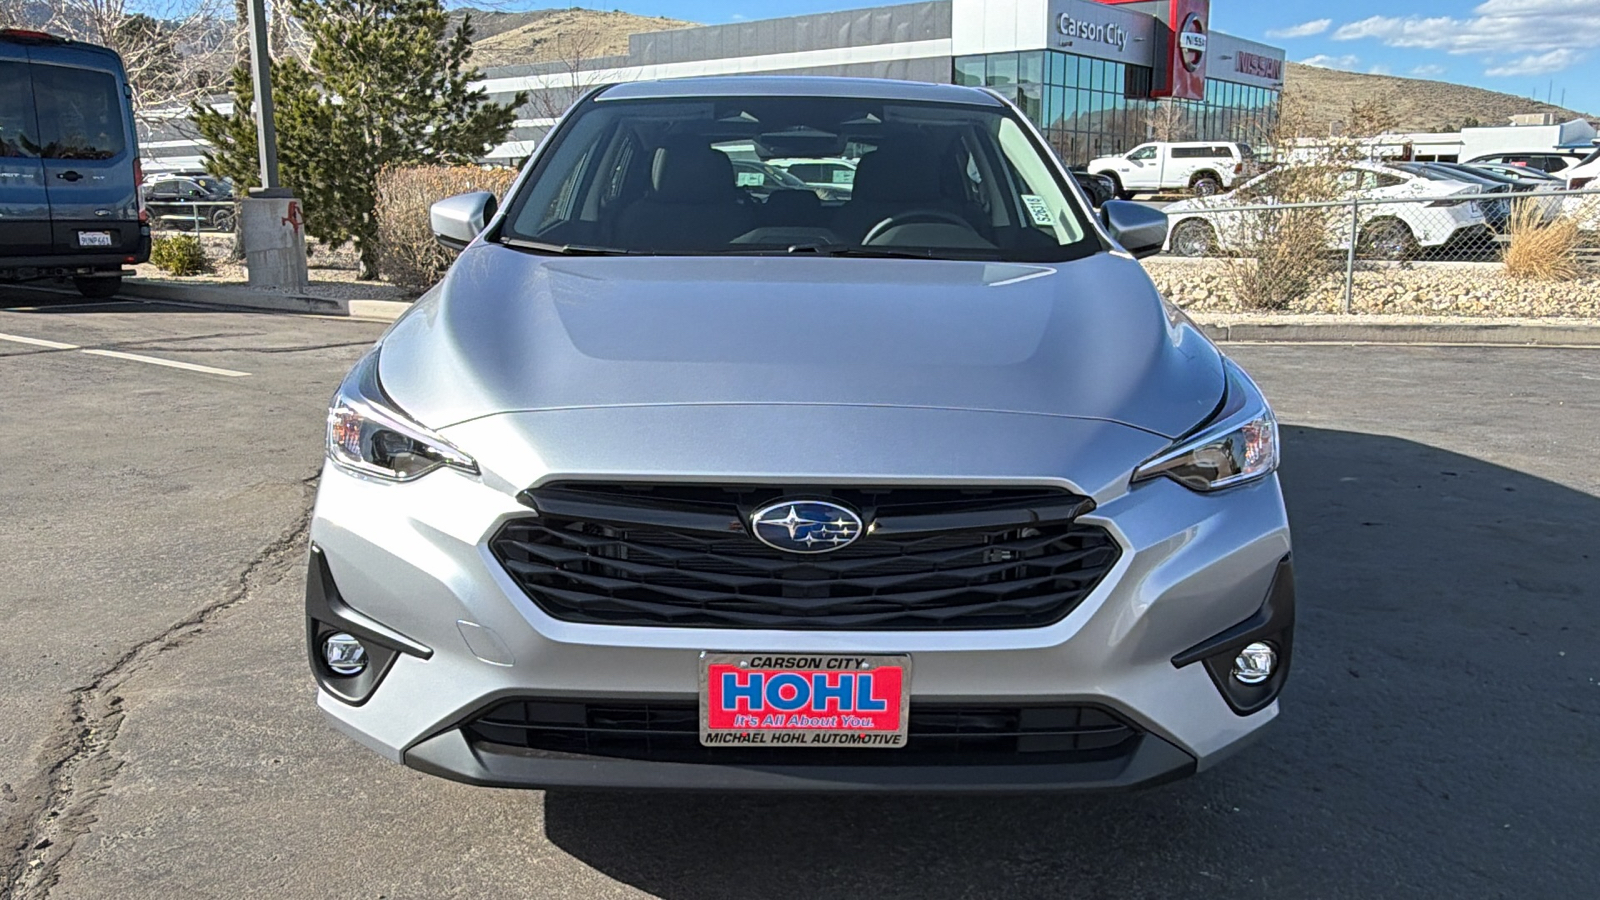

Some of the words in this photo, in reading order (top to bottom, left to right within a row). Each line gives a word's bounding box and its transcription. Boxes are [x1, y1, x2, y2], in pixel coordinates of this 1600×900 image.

[1059, 12, 1104, 42] Carson
[1107, 22, 1129, 52] City
[1186, 35, 1206, 47] NISS
[1235, 51, 1282, 80] NISSAN
[750, 656, 825, 669] CARSON
[827, 657, 866, 669] CITY
[722, 672, 887, 712] HOHL
[734, 714, 758, 726] It's
[762, 714, 785, 726] All
[788, 714, 838, 727] About
[841, 715, 874, 728] You.
[705, 732, 767, 744] MICHAEL
[770, 732, 808, 744] HOHL
[810, 733, 902, 745] AUTOMOTIVE
